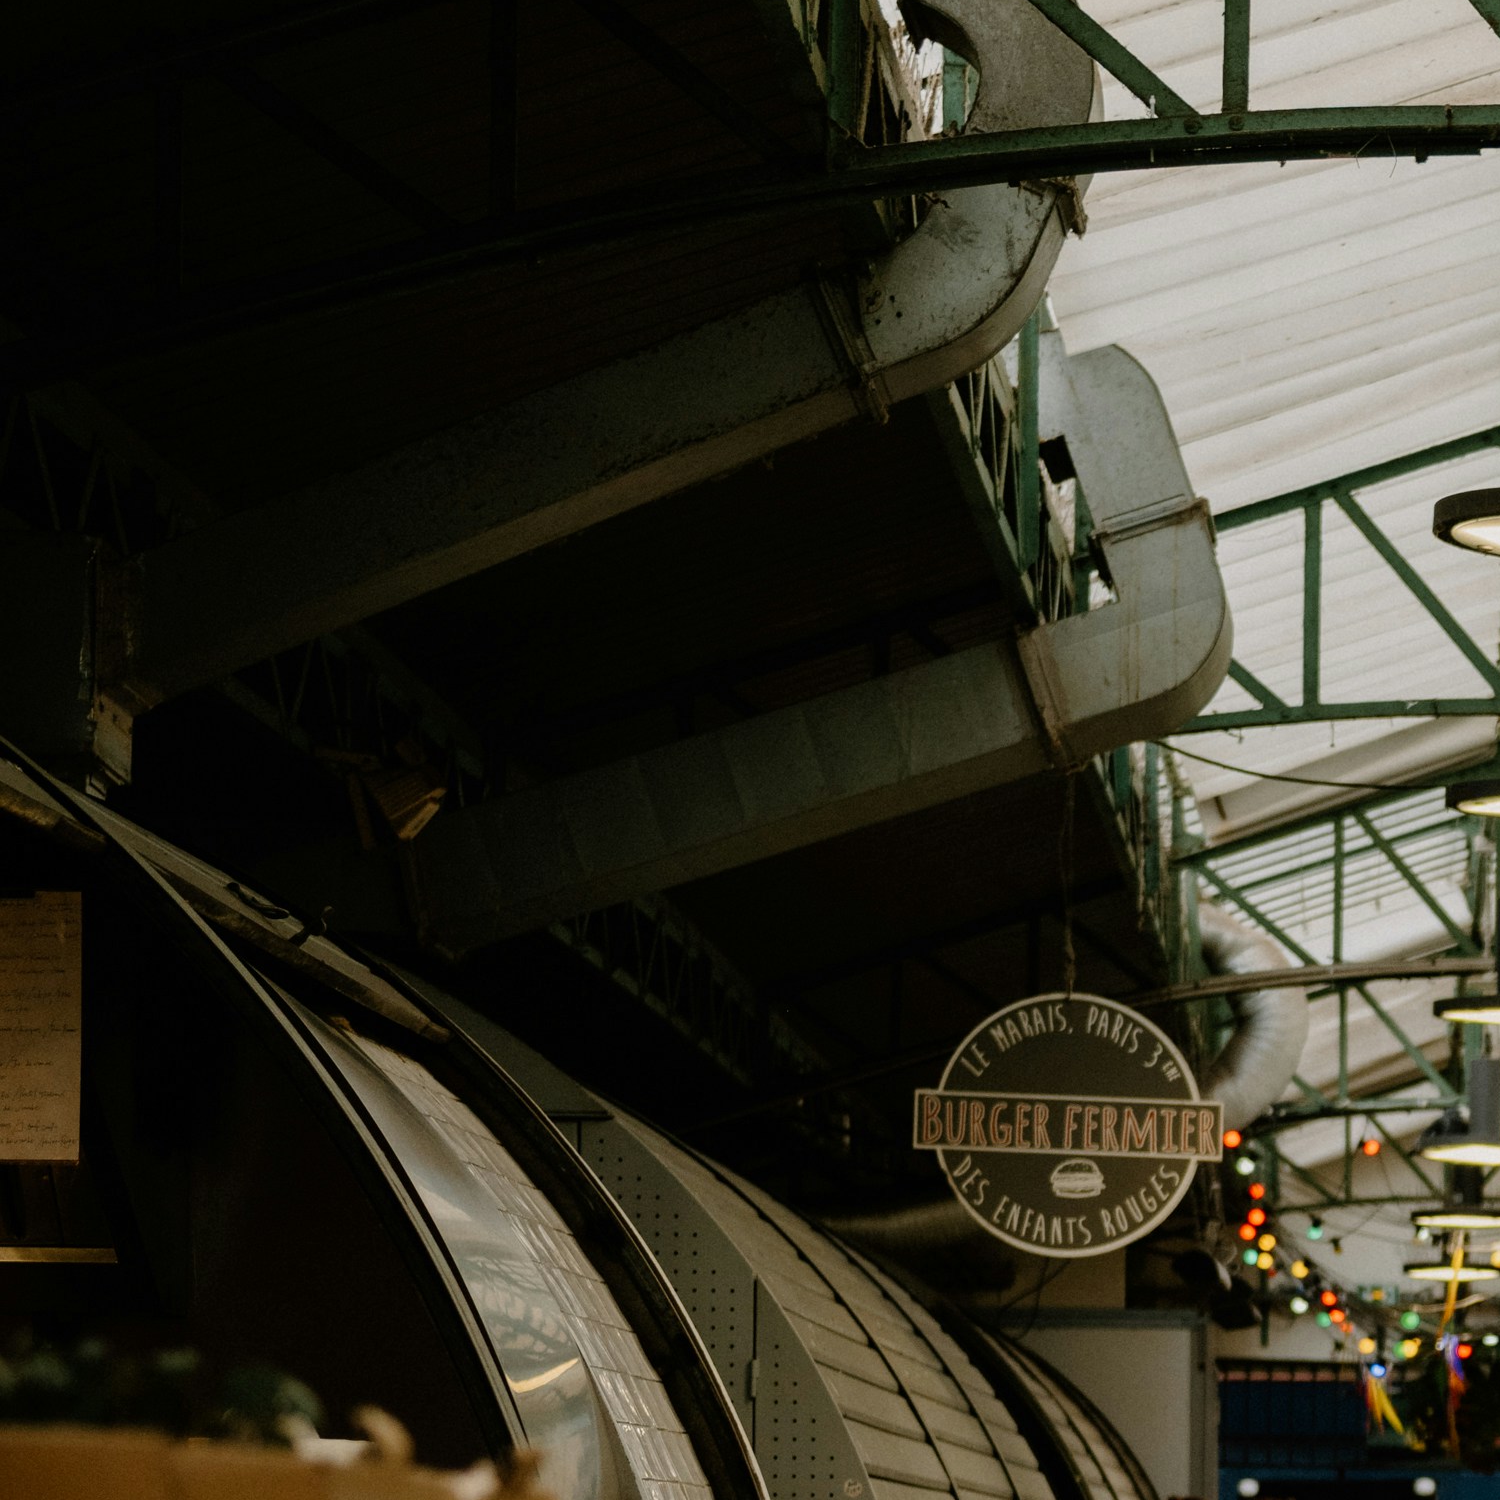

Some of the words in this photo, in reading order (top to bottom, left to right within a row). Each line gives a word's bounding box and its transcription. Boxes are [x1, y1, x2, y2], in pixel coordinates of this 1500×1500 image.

[960, 1043, 991, 1077] LE
[1086, 1005, 1143, 1054] PARIS
[922, 1094, 1051, 1149] BURGER
[1063, 1103, 1216, 1156] FERMIER
[952, 1155, 990, 1206] DES
[991, 1196, 1092, 1246] ENFANTS
[1100, 1164, 1180, 1238] ROUGES
